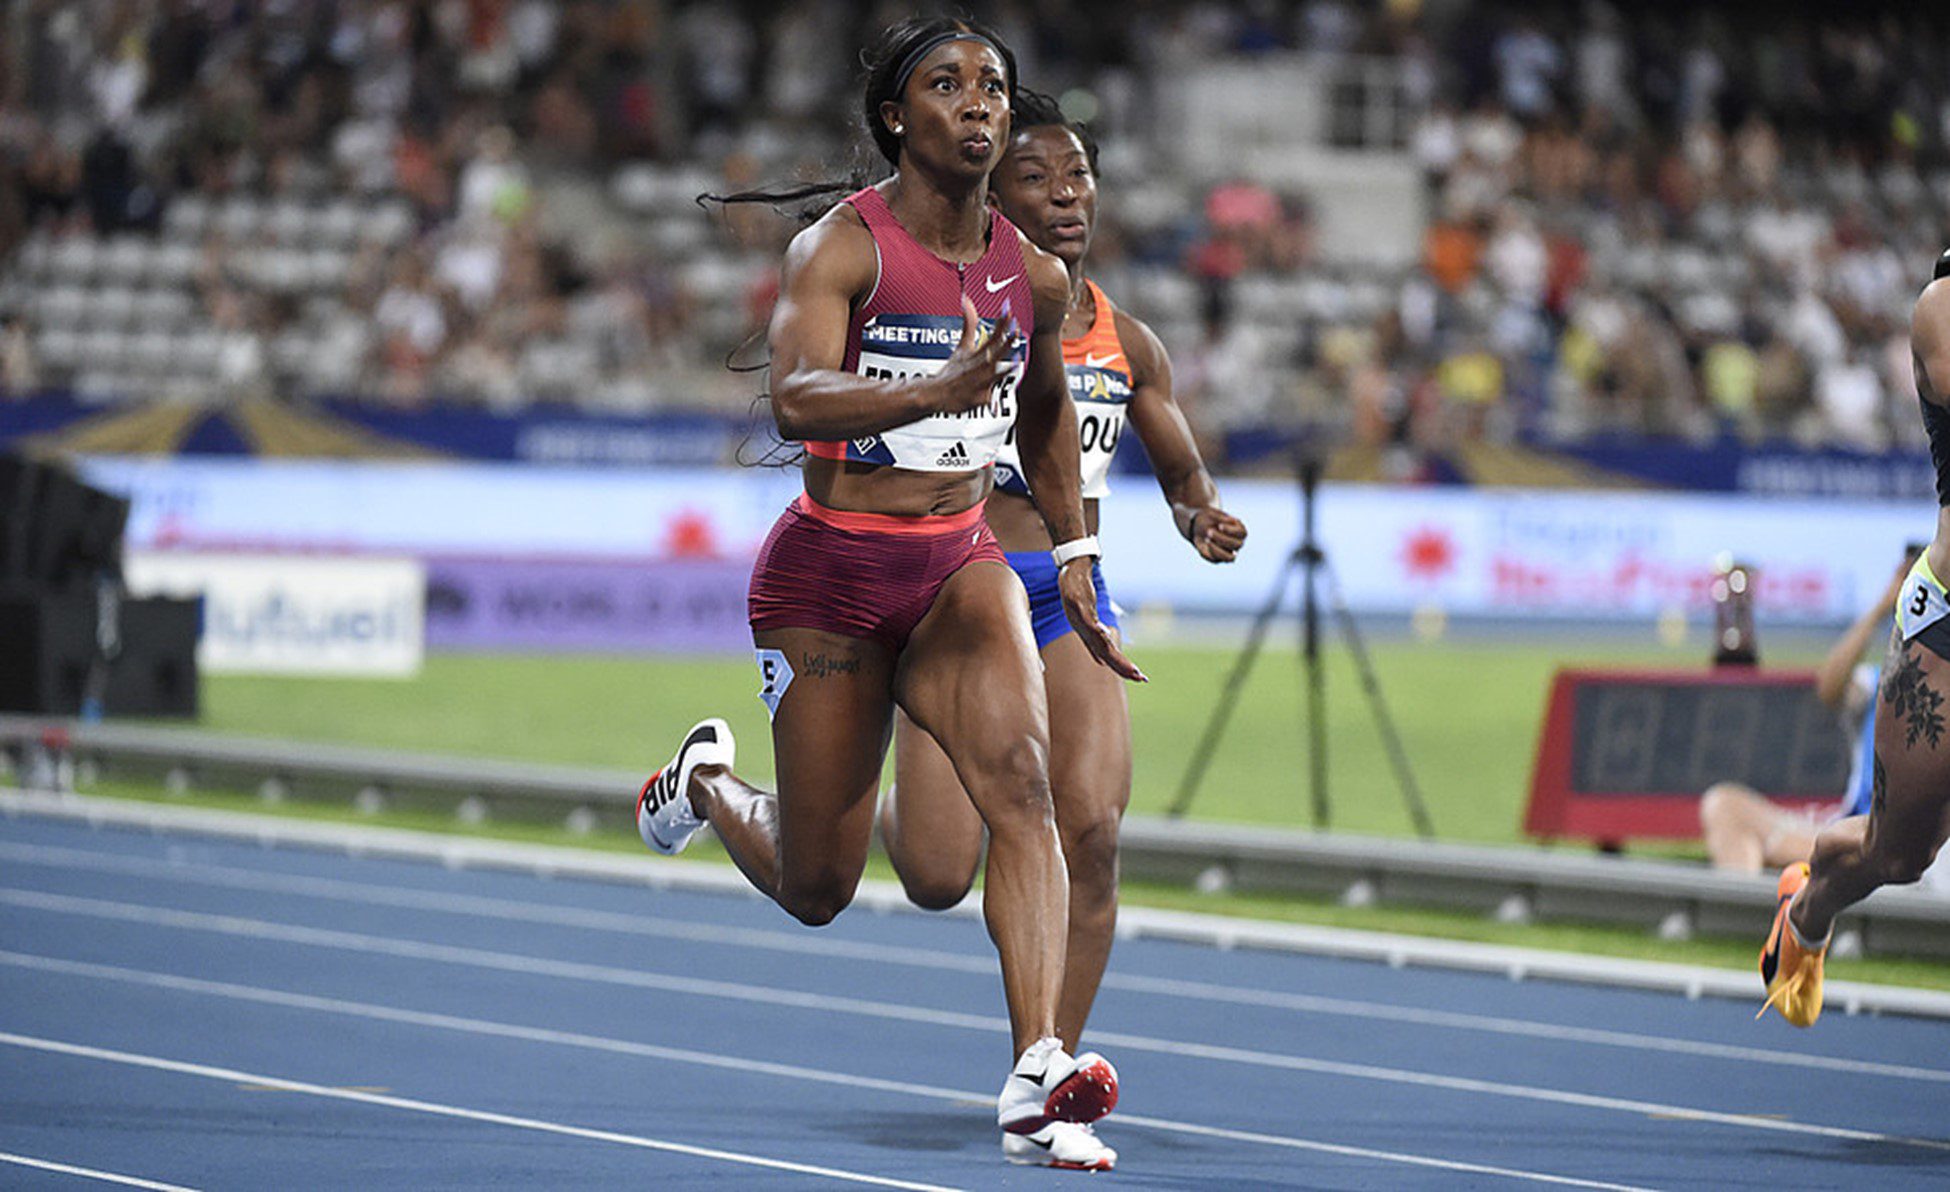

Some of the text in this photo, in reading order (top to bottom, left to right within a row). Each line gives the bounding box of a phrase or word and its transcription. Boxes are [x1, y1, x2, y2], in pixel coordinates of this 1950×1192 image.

[868, 325, 950, 345] MEETING
[1080, 415, 1120, 453] OU
[1910, 585, 1929, 617] 3
